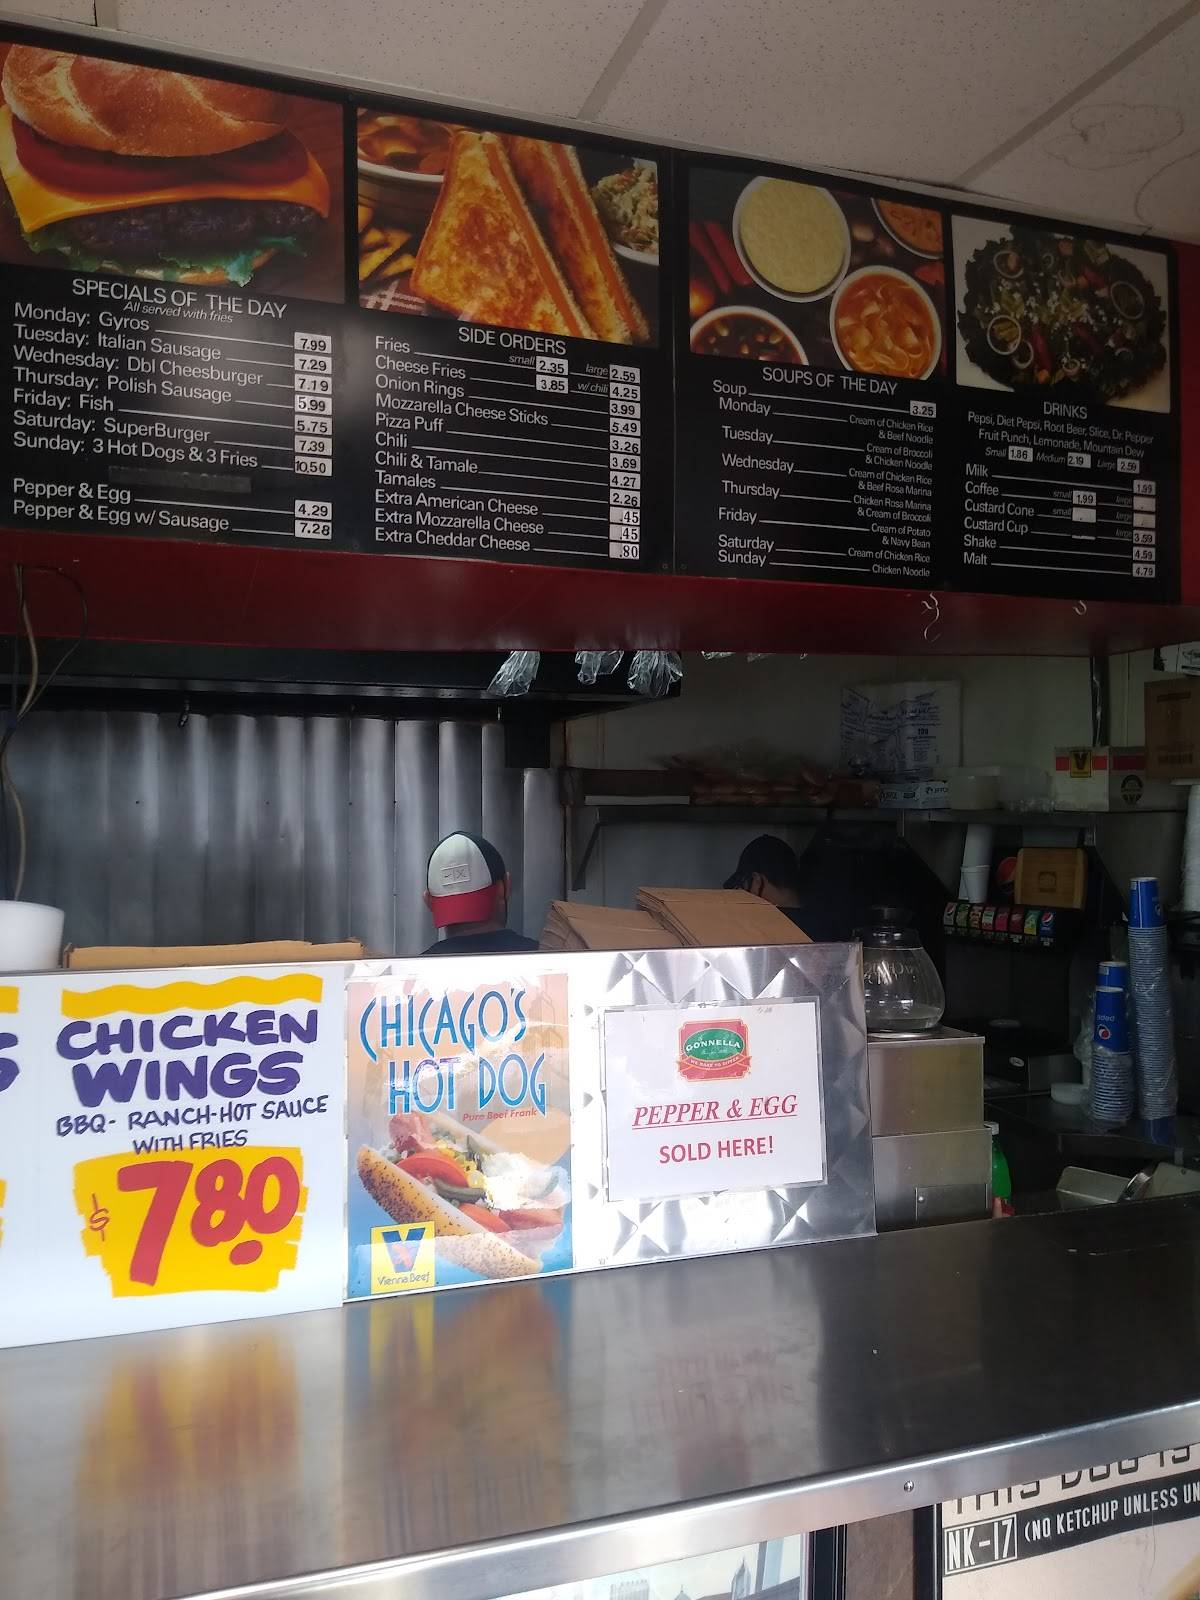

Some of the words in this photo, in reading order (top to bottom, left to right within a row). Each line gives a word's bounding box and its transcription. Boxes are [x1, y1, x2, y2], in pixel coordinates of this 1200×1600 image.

[72, 279, 166, 305] SPECIALS
[171, 290, 197, 306] OF
[206, 294, 243, 314] THE
[247, 300, 287, 319] DAY
[124, 302, 139, 312] All
[141, 305, 180, 317] served
[183, 309, 207, 320] with
[209, 310, 233, 323] fries
[14, 302, 90, 327] Monday:
[98, 312, 149, 331] Gyros
[299, 338, 327, 351] 7.99
[458, 327, 495, 346] SIDE
[500, 333, 566, 355] ORDERS
[14, 324, 90, 346] Tuesday:
[98, 335, 146, 351] Italian
[150, 338, 221, 360] Sausage
[299, 358, 327, 371] 7.29
[375, 336, 410, 353] Fries
[509, 355, 535, 365] small
[539, 360, 565, 374] 2.35
[586, 364, 608, 376] large
[611, 369, 636, 382] 2.59
[14, 345, 119, 372] Wednesday:
[127, 357, 156, 373] Dbl
[160, 360, 263, 386] Cheesburger
[298, 378, 329, 392] 7.19
[375, 355, 428, 374] Cheese
[433, 363, 465, 379] Fries
[540, 379, 565, 391] 3.85
[612, 387, 638, 399] 4.25
[763, 367, 813, 386] SOUPS
[816, 372, 835, 387] OF
[840, 376, 866, 392] THE
[870, 378, 897, 395] DAY
[13, 367, 98, 391] Thursday:
[107, 376, 156, 394] Polish
[161, 383, 232, 402] Sausage
[298, 396, 325, 412] 5.99
[375, 374, 420, 392] Onion
[424, 380, 464, 398] Rings
[611, 404, 635, 415] 3.99
[713, 380, 746, 396] Soup
[912, 405, 933, 416] 3.25
[13, 389, 70, 410] Friday:
[79, 394, 113, 411] Fish
[297, 419, 328, 432] 5.75
[375, 393, 451, 414] Mozzarella
[455, 401, 505, 420] Cheese
[509, 408, 548, 425] Sticks
[611, 422, 637, 433] 5.49
[719, 397, 770, 416] Monday
[968, 411, 995, 425] Pepsi,
[997, 415, 1014, 426] Diet
[1016, 418, 1042, 431] Pepsi,
[1044, 421, 1064, 432] Root
[1044, 402, 1087, 419] DRINKS
[13, 410, 96, 432] Saturday:
[103, 419, 210, 442] SuperBurger
[299, 440, 325, 452] 7.39
[375, 412, 410, 429] Pizza
[414, 416, 443, 432] Puff
[612, 440, 639, 453] 3.26
[722, 426, 773, 445] Tuesday
[979, 430, 999, 441] Fruit
[13, 432, 84, 453] Sunday:
[93, 439, 104, 453] 3
[107, 440, 137, 457] Hot
[141, 445, 185, 463] Dogs
[189, 449, 203, 462] &
[206, 449, 216, 462] 3
[220, 451, 258, 467] Fries
[295, 461, 327, 474] 10.50
[375, 432, 408, 448] Chili
[612, 457, 637, 469] 3.69
[722, 453, 794, 474] Wednesday
[375, 451, 408, 467] Chili
[411, 454, 423, 467] &
[426, 456, 478, 473] Tamale
[611, 475, 636, 487] 4.27
[966, 463, 988, 477] Milk
[14, 478, 74, 501] Pepper
[79, 483, 94, 498] &
[98, 484, 131, 504] Egg
[298, 504, 328, 517] 4.29
[375, 470, 435, 489] Tamales
[612, 493, 638, 506] 2.26
[722, 480, 779, 499] Thursday
[965, 481, 999, 496] Coffee
[14, 501, 74, 522] Pepper
[79, 505, 93, 520] &
[98, 506, 131, 526] Egg
[135, 509, 155, 524] w/
[159, 512, 229, 531] Sausage
[300, 523, 330, 536] 7.28
[375, 489, 412, 505] Extra
[416, 493, 485, 510] American
[490, 497, 538, 515] Cheese
[620, 511, 639, 523] .45
[718, 507, 757, 525] Friday
[965, 499, 1004, 514] Custard
[1007, 503, 1034, 516] Cone
[375, 508, 412, 524] Extra
[416, 512, 490, 530] Mozzarella
[494, 518, 544, 534] Cheese
[619, 528, 638, 540] .45
[964, 516, 1004, 532] Custard
[1007, 520, 1028, 535] Cup
[375, 527, 412, 542] Extra
[416, 530, 476, 547] Cheddar
[480, 534, 530, 551] Cheese
[619, 545, 638, 558] .80
[718, 534, 774, 552] Saturday
[964, 535, 996, 548] Shake
[718, 550, 766, 567] Sunday
[964, 552, 987, 566] Malt
[57, 1009, 318, 1060] CHICKEN
[360, 987, 526, 1062] CHICAGO'S
[686, 1039, 740, 1052] GONNELLA
[72, 1051, 303, 1108] WINGS
[389, 1057, 461, 1115] HOT
[479, 1052, 545, 1116] DOG
[262, 1095, 329, 1120] SAUCE
[463, 1112, 485, 1121] Pure
[488, 1111, 508, 1121] Beef
[510, 1109, 537, 1119] Frank
[633, 1101, 719, 1127] PEPPER
[727, 1099, 742, 1118] &
[750, 1094, 797, 1116] EGG
[133, 1136, 182, 1155] WITH
[190, 1130, 248, 1150] FRIES
[660, 1142, 711, 1163] SOLD
[718, 1136, 774, 1158] HERE!
[1025, 1518, 1050, 1542] (NO
[1057, 1503, 1118, 1535] KETCHUP
[1124, 1487, 1177, 1516] UNLESS
[948, 1519, 1013, 1570] NK-17
